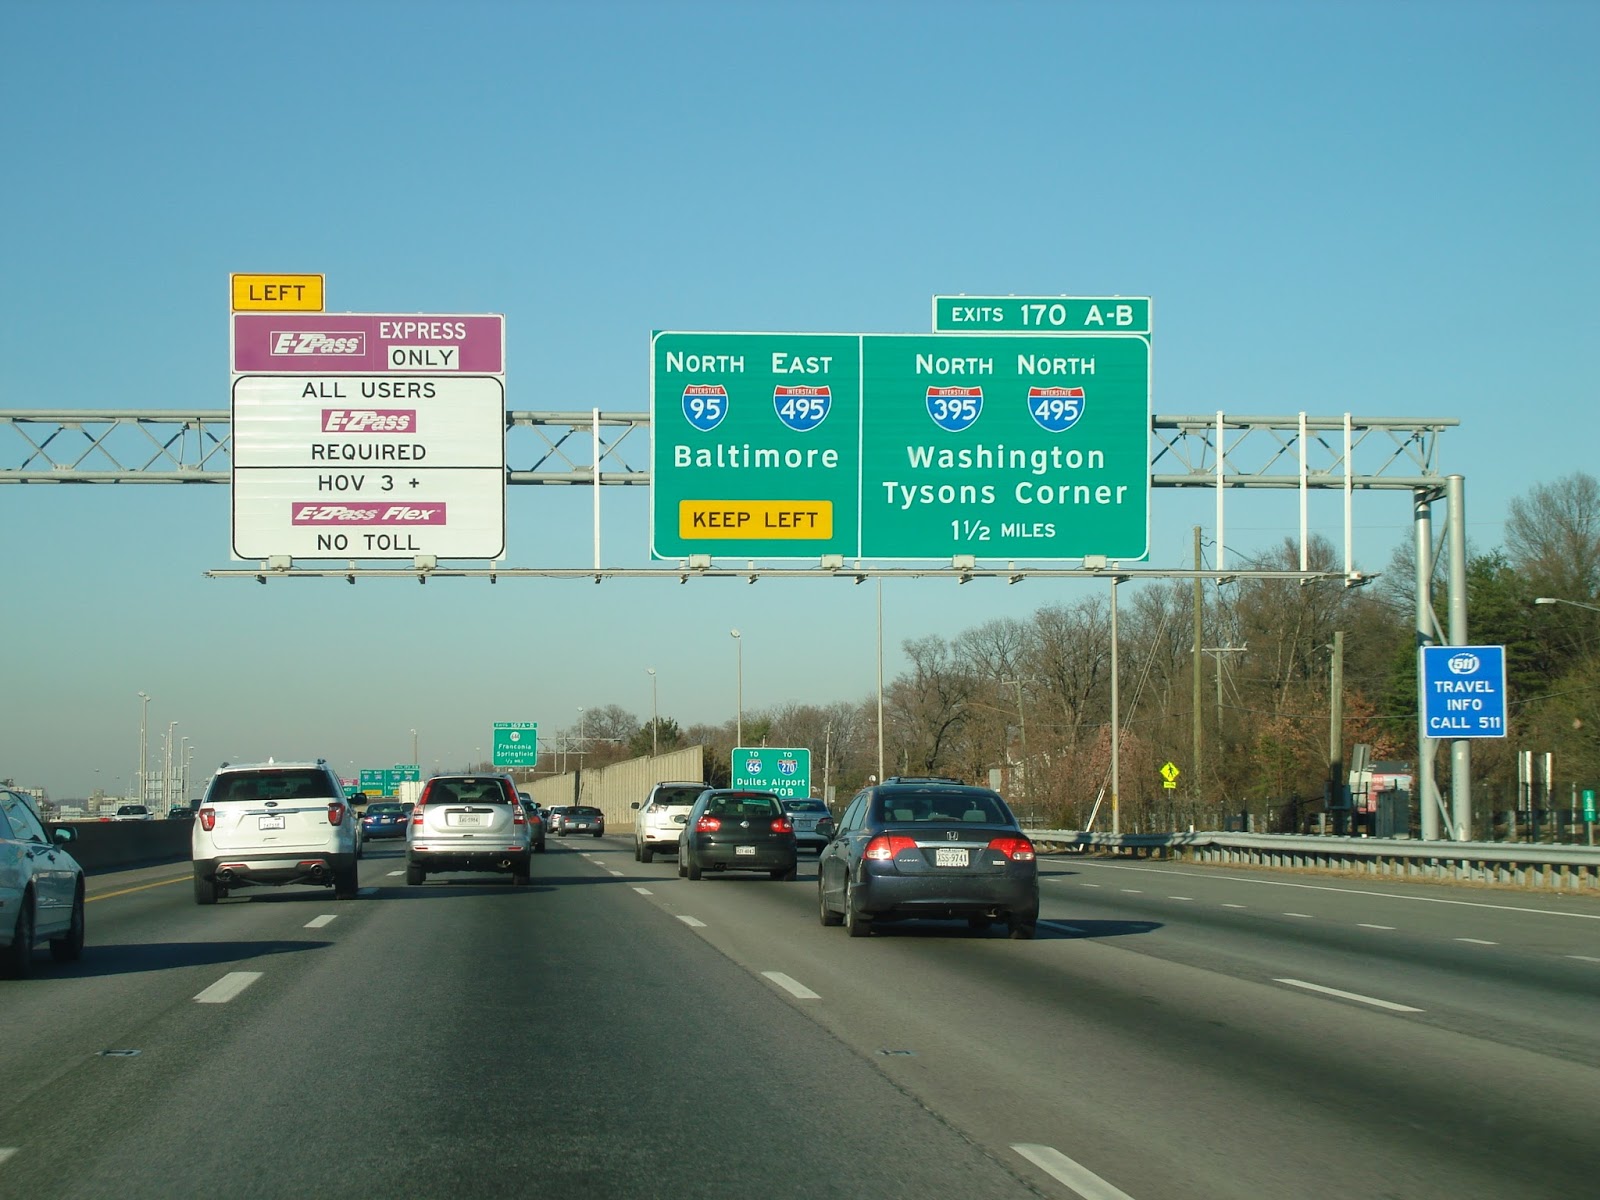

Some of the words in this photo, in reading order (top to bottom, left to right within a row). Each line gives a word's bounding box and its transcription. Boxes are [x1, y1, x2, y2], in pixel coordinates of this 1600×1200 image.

[249, 284, 306, 301] LEFT
[951, 306, 1003, 323] EXITS
[1020, 304, 1066, 326] 170
[1084, 304, 1133, 326] A-B
[379, 322, 467, 340] EXPRESS
[391, 349, 454, 366] ONLY
[301, 382, 347, 398] ALL
[361, 382, 436, 399] USERS
[689, 387, 721, 395] INTERSTATE
[689, 398, 721, 420] 95
[780, 398, 825, 420] 495
[933, 399, 977, 421] 395
[1034, 399, 1079, 421] 495
[311, 444, 426, 461] REQUIRED
[674, 444, 839, 469] Baltimore
[906, 445, 1105, 475] Washington
[318, 474, 365, 491] HOV
[381, 474, 394, 491] 3
[882, 481, 996, 510] Tysons
[1015, 482, 1127, 504] Corner
[381, 506, 436, 521] Flex
[693, 511, 751, 528] KEEP
[764, 511, 818, 528] LEFT
[1001, 522, 1056, 538] MILES
[317, 534, 348, 550] NO
[363, 534, 421, 550] TOLL
[1453, 658, 1474, 670] 511
[1434, 681, 1494, 693] TRAVEL
[1447, 699, 1482, 711] INFO
[1430, 717, 1471, 729] CALL
[1479, 717, 1500, 729] 511
[748, 762, 760, 772] 66
[781, 763, 795, 773] 270
[736, 777, 767, 786] Dulles
[771, 778, 806, 787] Airport
